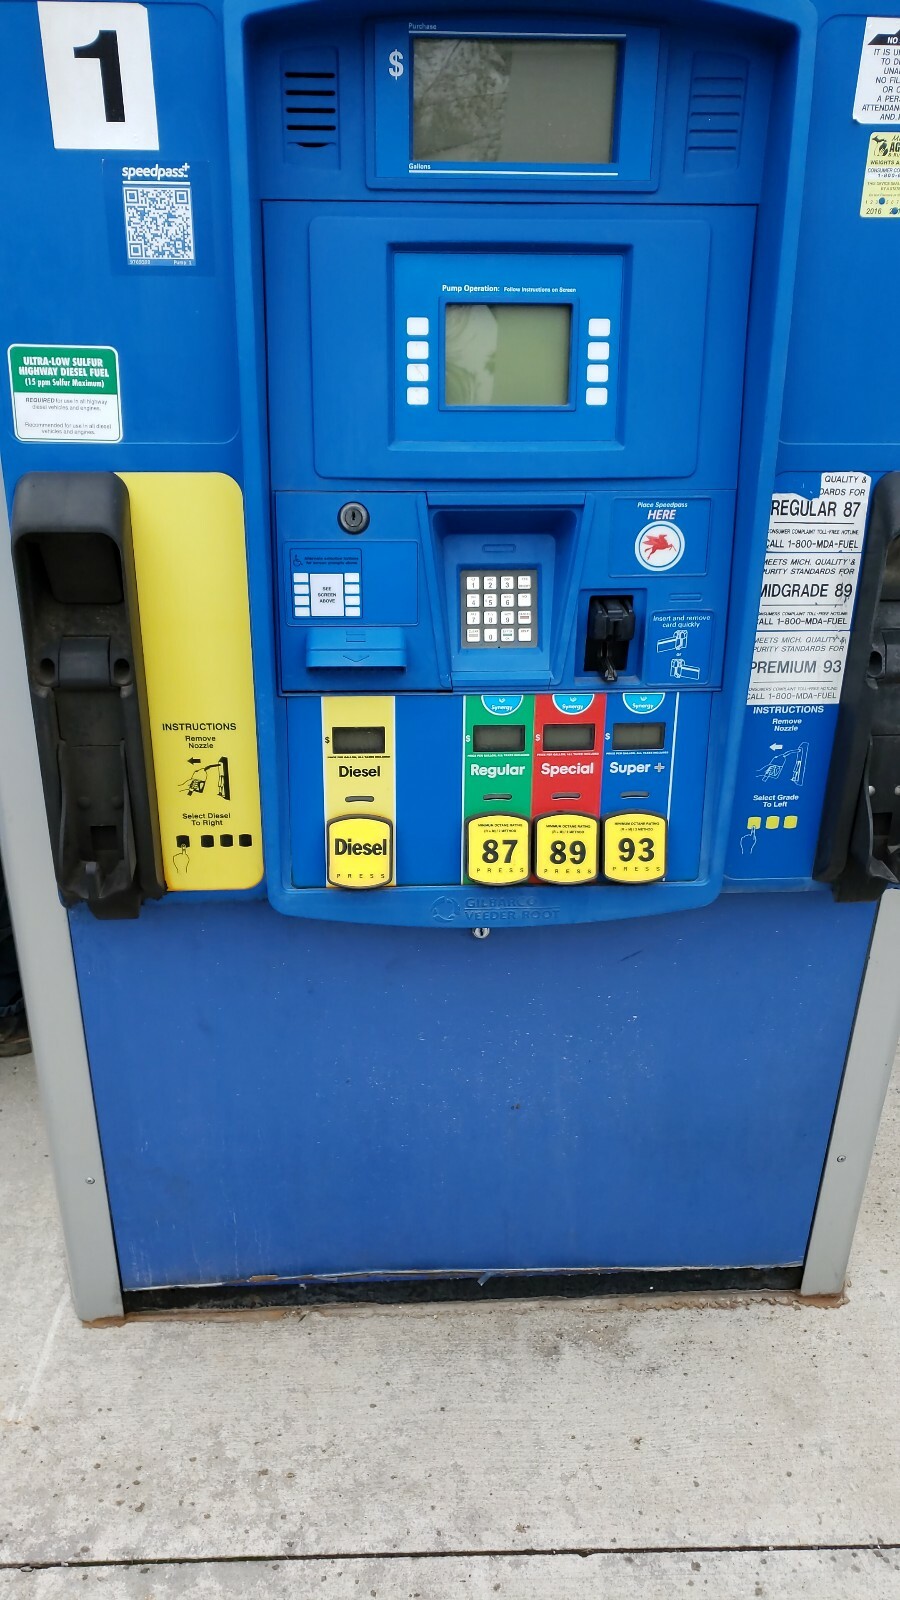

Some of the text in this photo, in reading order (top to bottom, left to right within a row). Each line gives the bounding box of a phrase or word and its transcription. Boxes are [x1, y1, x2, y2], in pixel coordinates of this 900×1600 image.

[886, 36, 898, 44] NO
[389, 49, 404, 80] $
[73, 30, 125, 122] 1
[442, 284, 462, 293] Pump
[464, 284, 500, 293] Operation:
[23, 356, 103, 367] ULTRA-LOW SULFUR
[18, 367, 109, 377] HIGHWAY DIESEL FUEL
[25, 378, 36, 386] (15
[53, 378, 70, 386] Sulfur
[72, 379, 104, 388] Maximum)
[648, 510, 676, 520] HERE
[771, 500, 861, 517] REGULAR 87
[788, 540, 858, 548] 1-800-MDA-FUEL
[834, 583, 852, 598] 89
[751, 660, 842, 674] PREMIUM 93
[753, 705, 824, 714] INSTRUCTIONS
[338, 766, 380, 777] Diesel
[471, 764, 525, 779] Regular
[541, 763, 594, 777] Special
[610, 762, 651, 776] Super
[335, 838, 387, 855] Diesel
[481, 839, 518, 864] 87
[549, 840, 586, 865] 89
[618, 838, 655, 862] 93
[465, 897, 537, 907] GILBARCO
[464, 910, 560, 920] VEEDER ROOT
